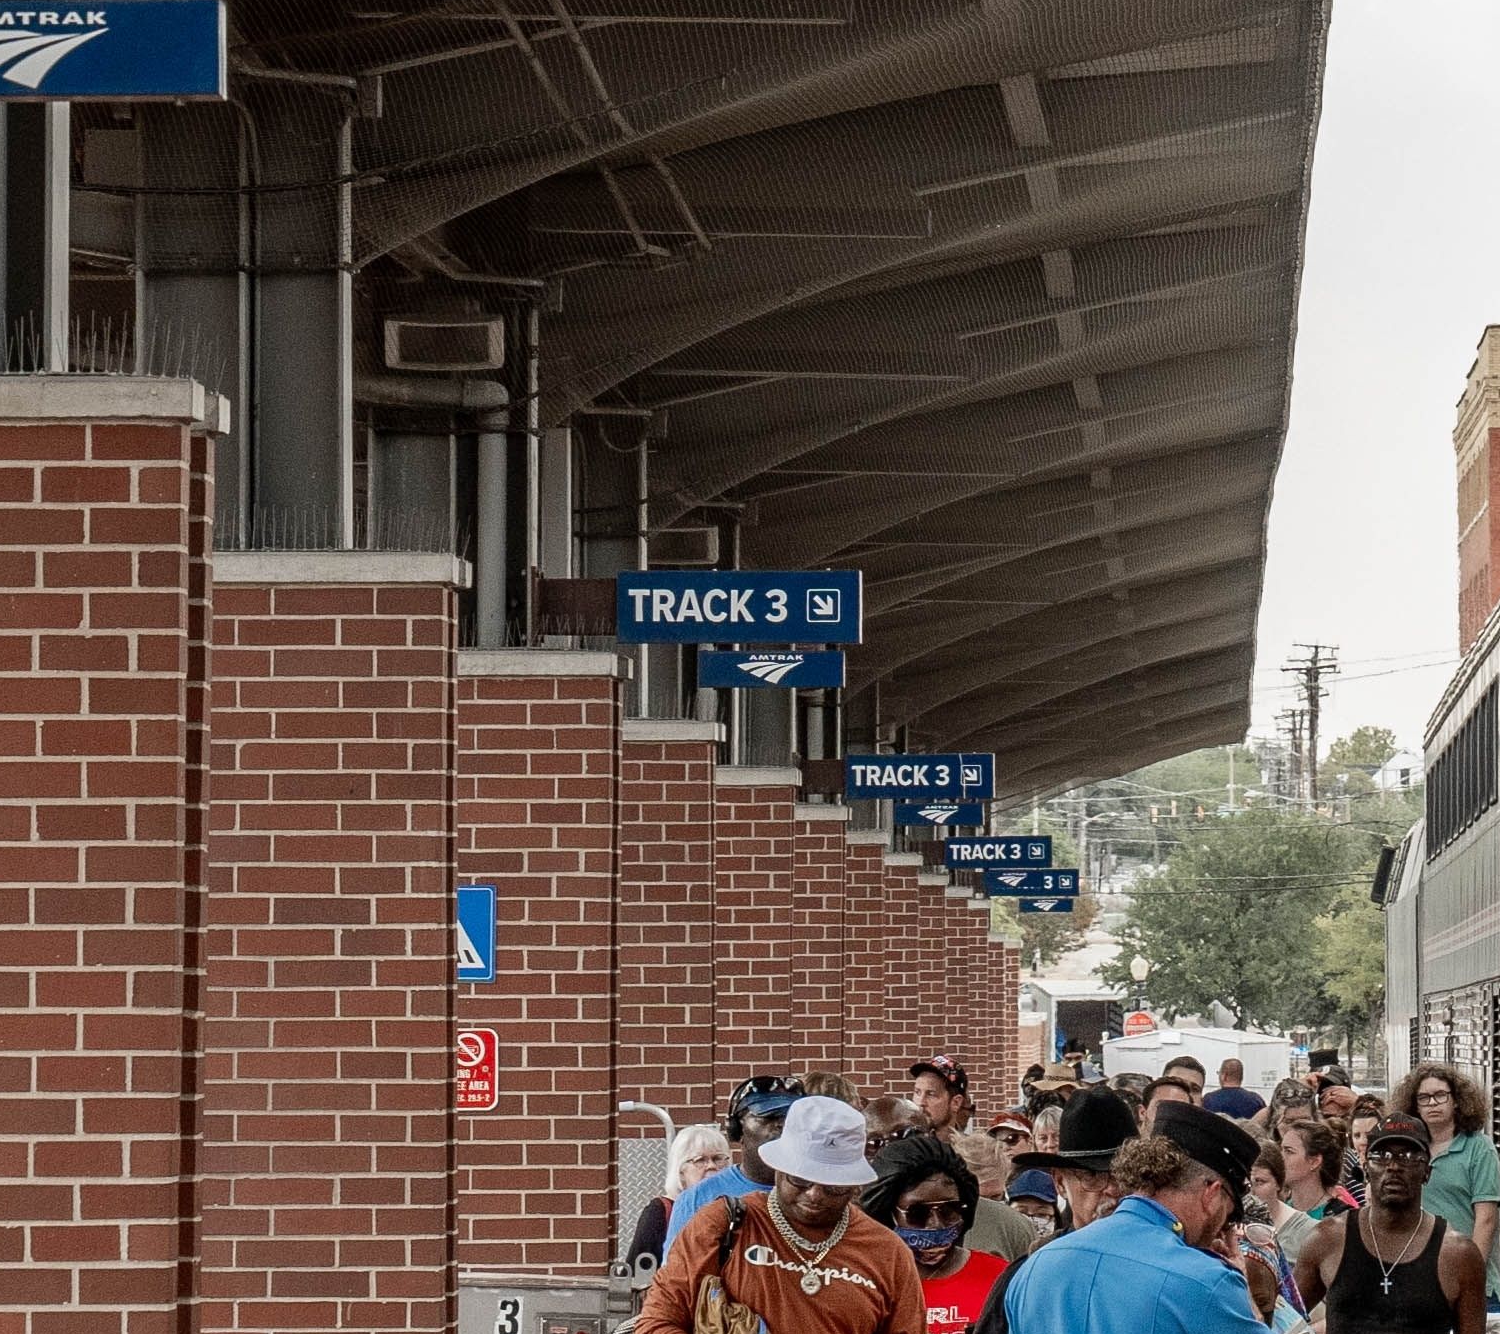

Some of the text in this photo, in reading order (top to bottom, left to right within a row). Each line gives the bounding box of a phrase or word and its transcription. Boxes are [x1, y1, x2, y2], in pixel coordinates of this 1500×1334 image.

[628, 588, 788, 623] TRACK 3
[851, 764, 950, 786] TRACK 3
[949, 843, 1022, 861] TRACK 3
[1043, 876, 1053, 889] 3
[468, 1080, 490, 1091] AREA
[744, 1244, 877, 1290] Champion
